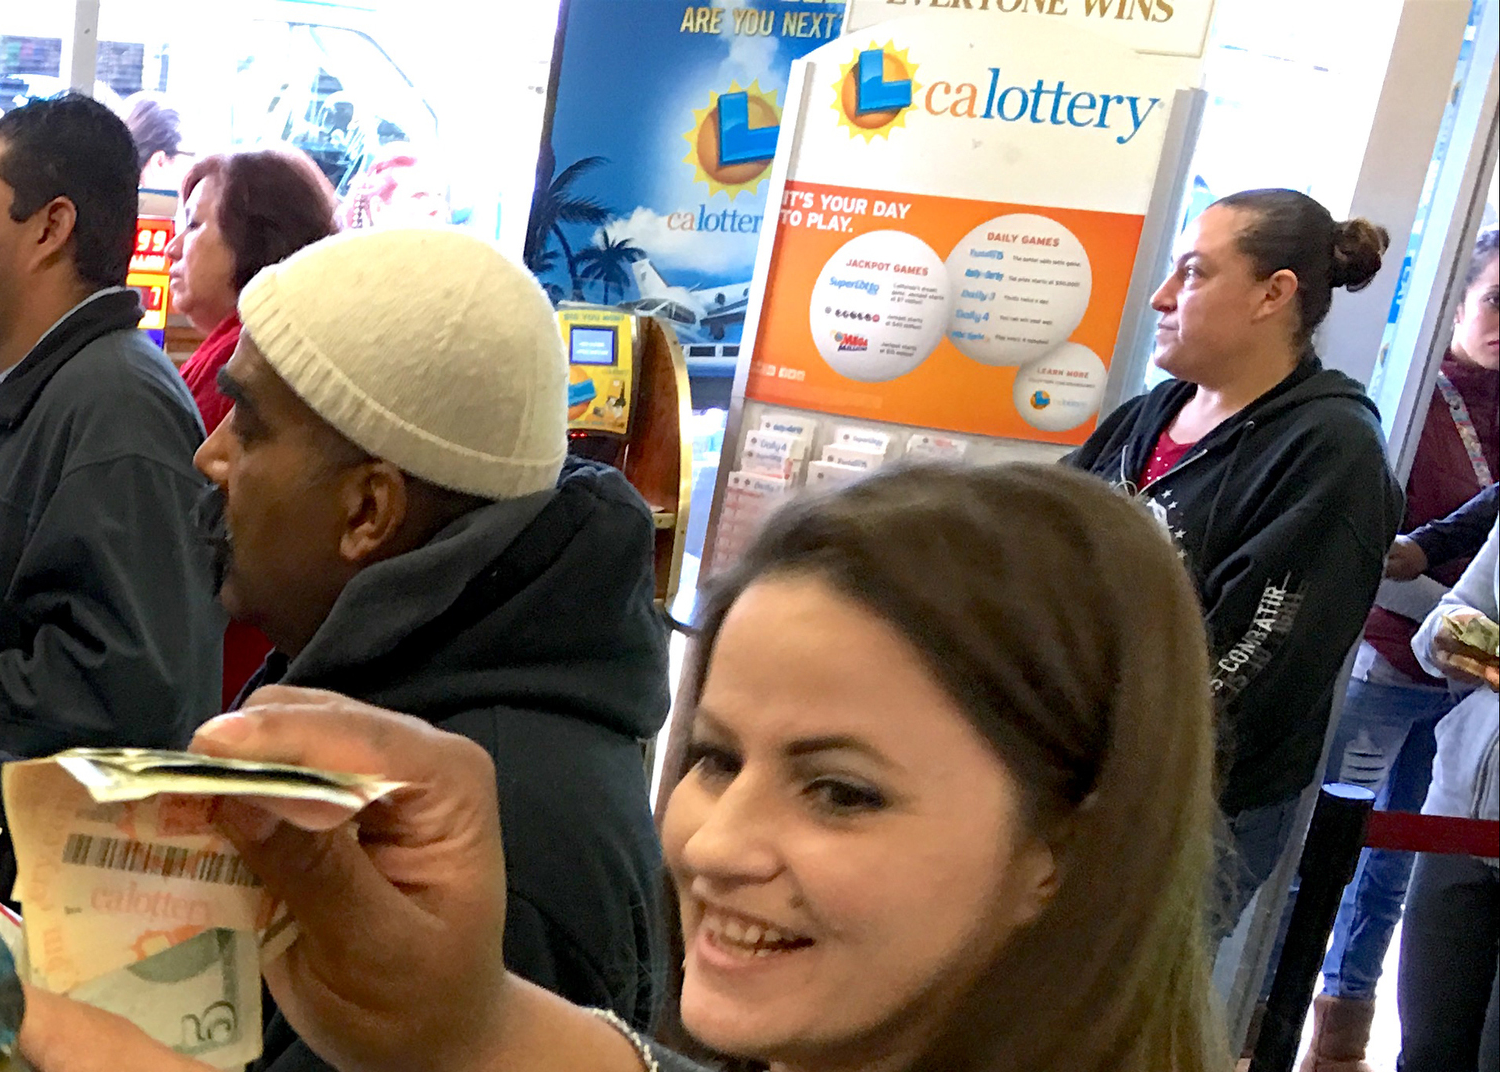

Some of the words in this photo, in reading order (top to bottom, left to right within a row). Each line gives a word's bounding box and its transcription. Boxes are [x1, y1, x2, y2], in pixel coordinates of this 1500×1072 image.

[680, 7, 724, 34] ARE
[733, 8, 775, 37] YOU
[782, 11, 844, 39] NEXT
[924, 66, 1159, 144] calottery
[820, 194, 867, 216] YOUR
[873, 199, 911, 220] DAY
[780, 208, 804, 227] TO
[806, 212, 854, 233] PLAY.
[987, 232, 1019, 243] DAILY
[1021, 235, 1060, 247] GAMES
[846, 259, 891, 271] JACKPOT
[894, 264, 929, 277] GAMES
[1036, 367, 1064, 376] LEARN
[1066, 370, 1089, 379] MORE
